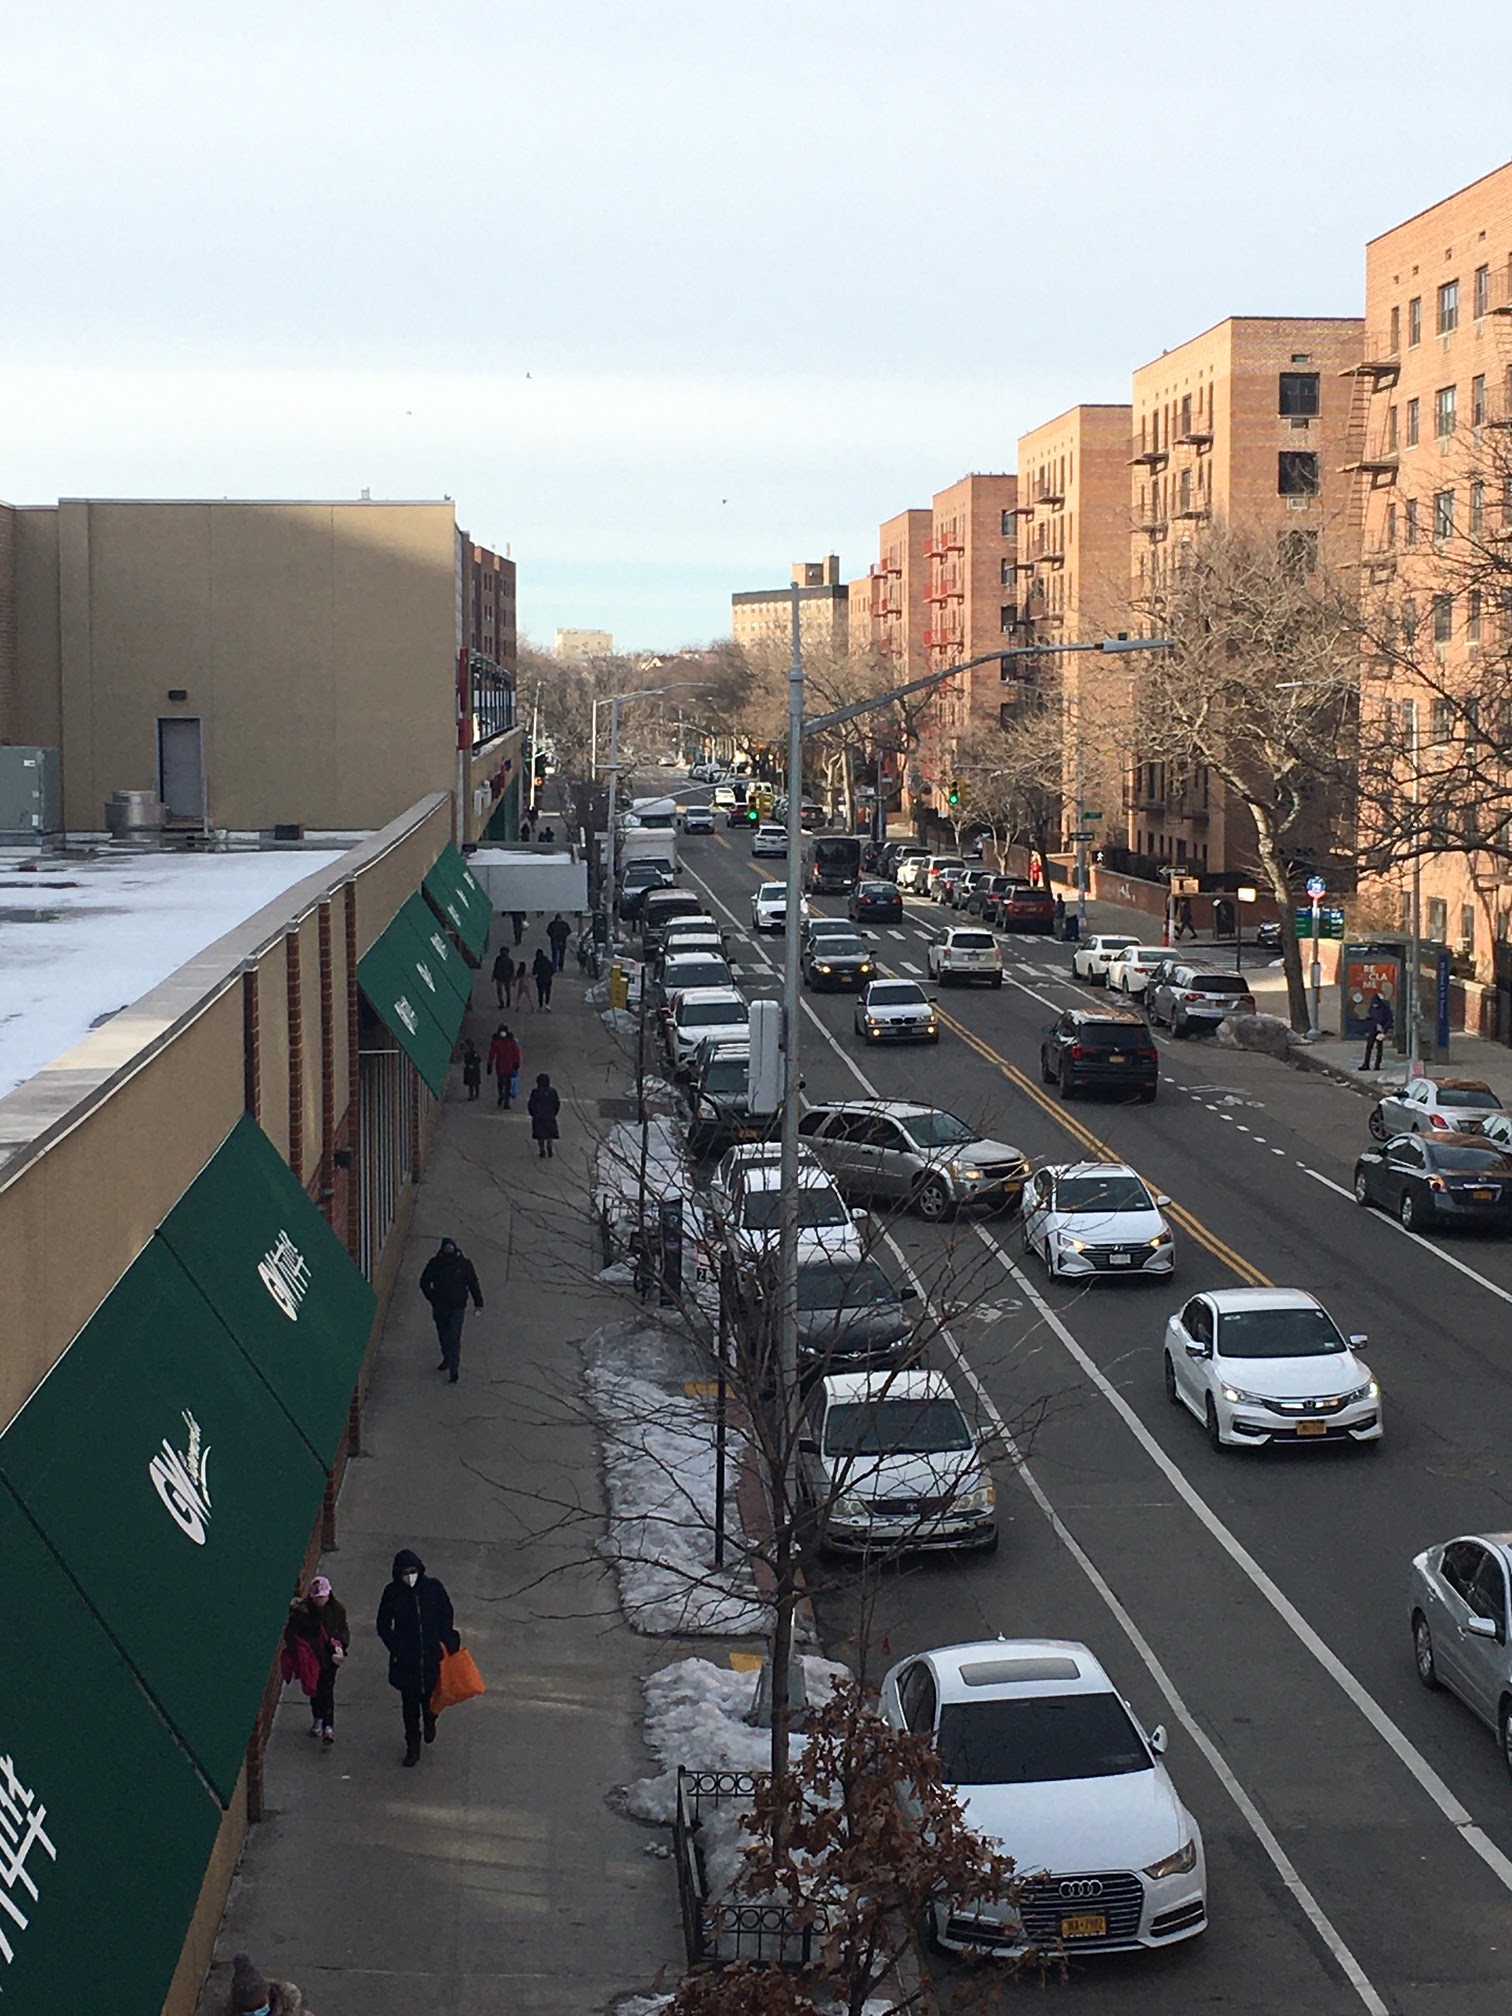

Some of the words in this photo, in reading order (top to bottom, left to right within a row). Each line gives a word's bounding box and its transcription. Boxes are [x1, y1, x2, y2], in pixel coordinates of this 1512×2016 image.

[1363, 964, 1377, 973] RE
[1368, 973, 1388, 981] CLA
[1362, 981, 1377, 989] ME
[149, 1438, 212, 1545] GW
